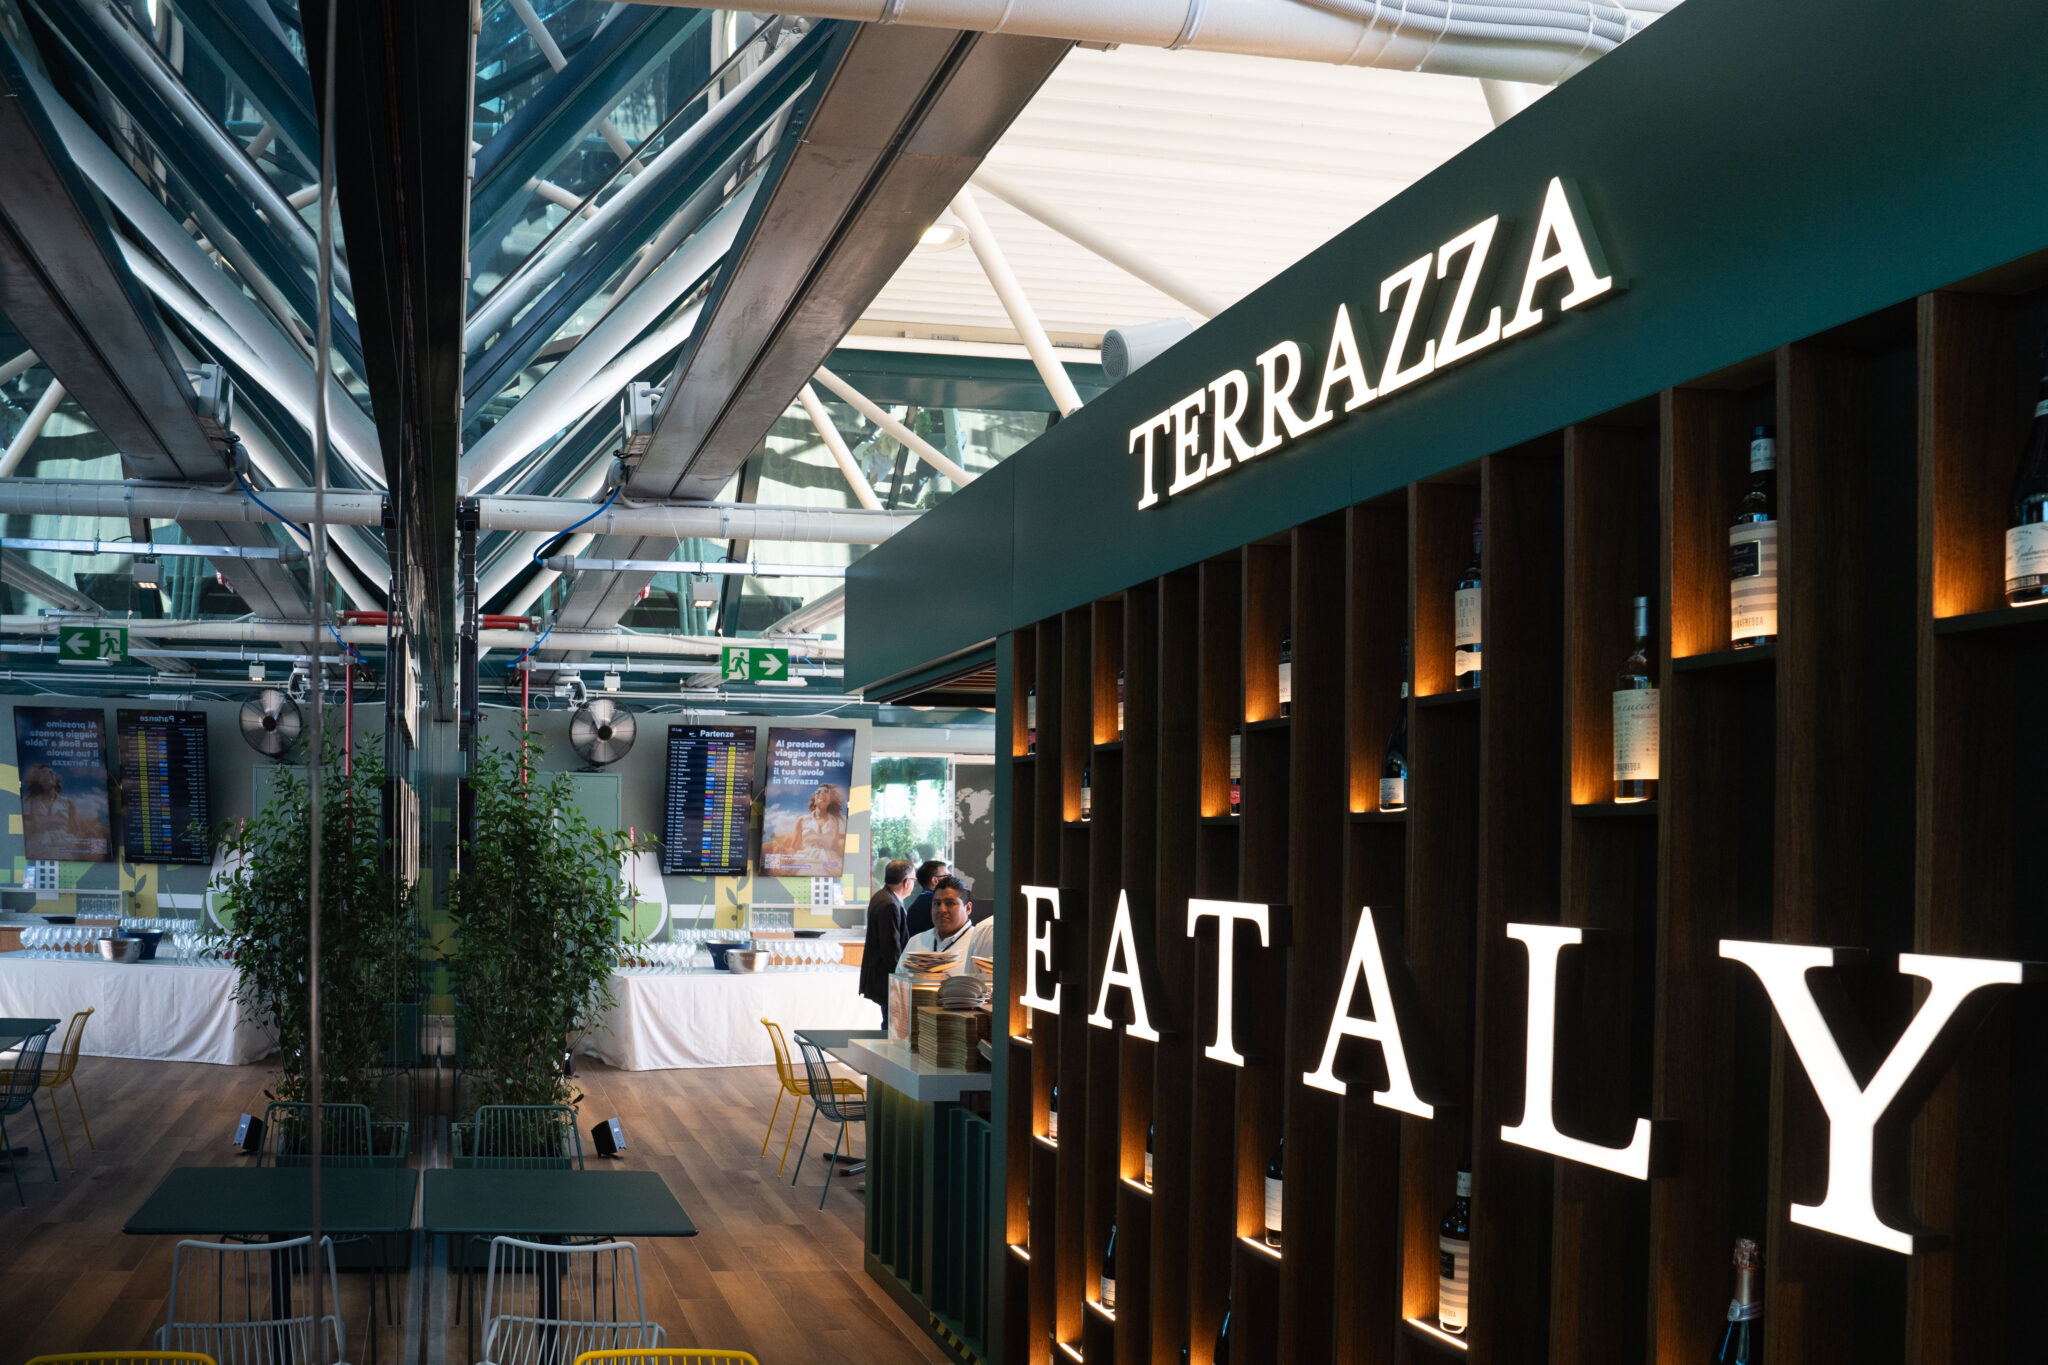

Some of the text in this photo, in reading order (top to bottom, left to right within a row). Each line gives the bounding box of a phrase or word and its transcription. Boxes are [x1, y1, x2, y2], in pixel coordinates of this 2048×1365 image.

[1129, 177, 1611, 510] TERRAZZA
[700, 729, 735, 738] Partenze
[786, 740, 825, 749] prossimo
[775, 749, 840, 759] viaggio prenota
[791, 759, 812, 767] Book
[822, 759, 845, 767] Table
[781, 768, 796, 776] tuo
[798, 768, 824, 776] tavolo
[773, 776, 819, 785] in Terrazza
[1020, 886, 2022, 1254] EATALY
